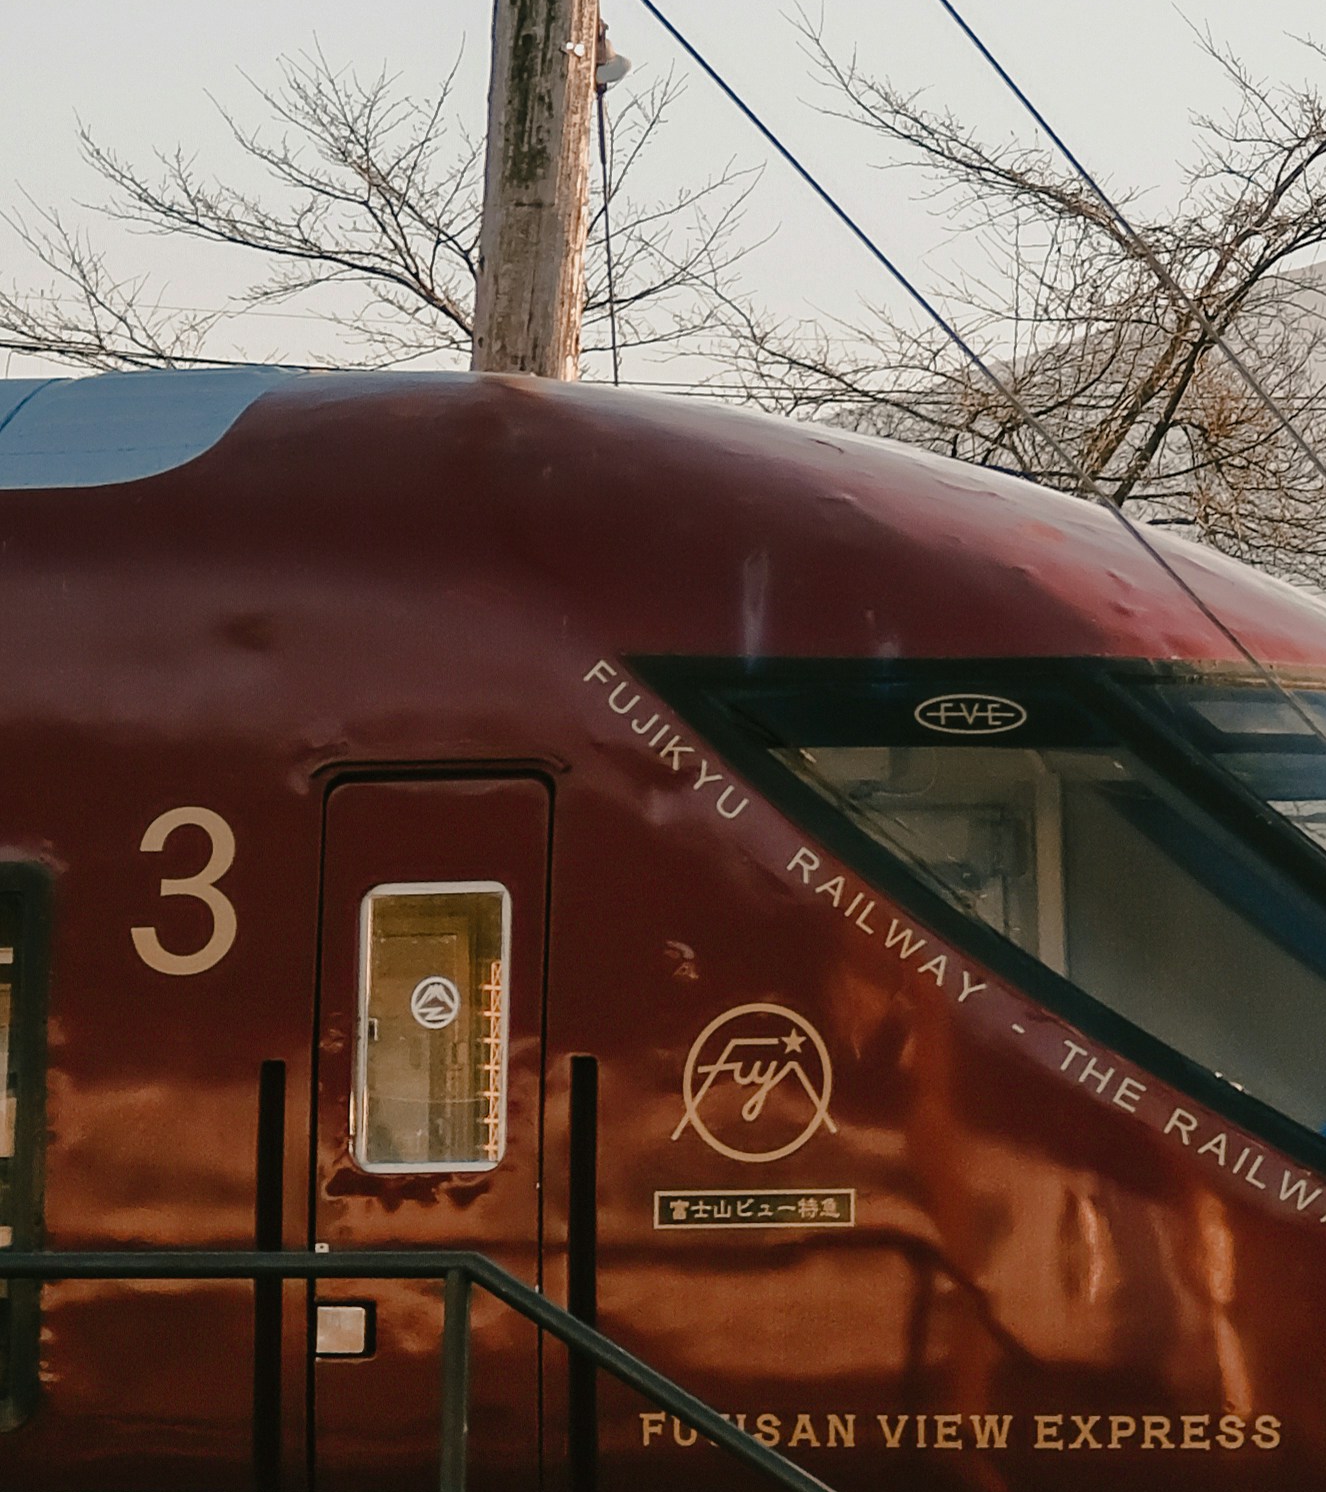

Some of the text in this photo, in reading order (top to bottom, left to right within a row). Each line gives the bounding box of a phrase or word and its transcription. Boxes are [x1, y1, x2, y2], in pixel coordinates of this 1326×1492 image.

[131, 807, 237, 975] 3
[583, 660, 749, 819] FUJIKYU
[787, 847, 987, 1003] RAILWAY
[1059, 1039, 1147, 1113] THE
[669, 1197, 841, 1221] 富士山ビュー特急
[640, 1411, 1283, 1451] FUISAN VIEW EXPRESS
